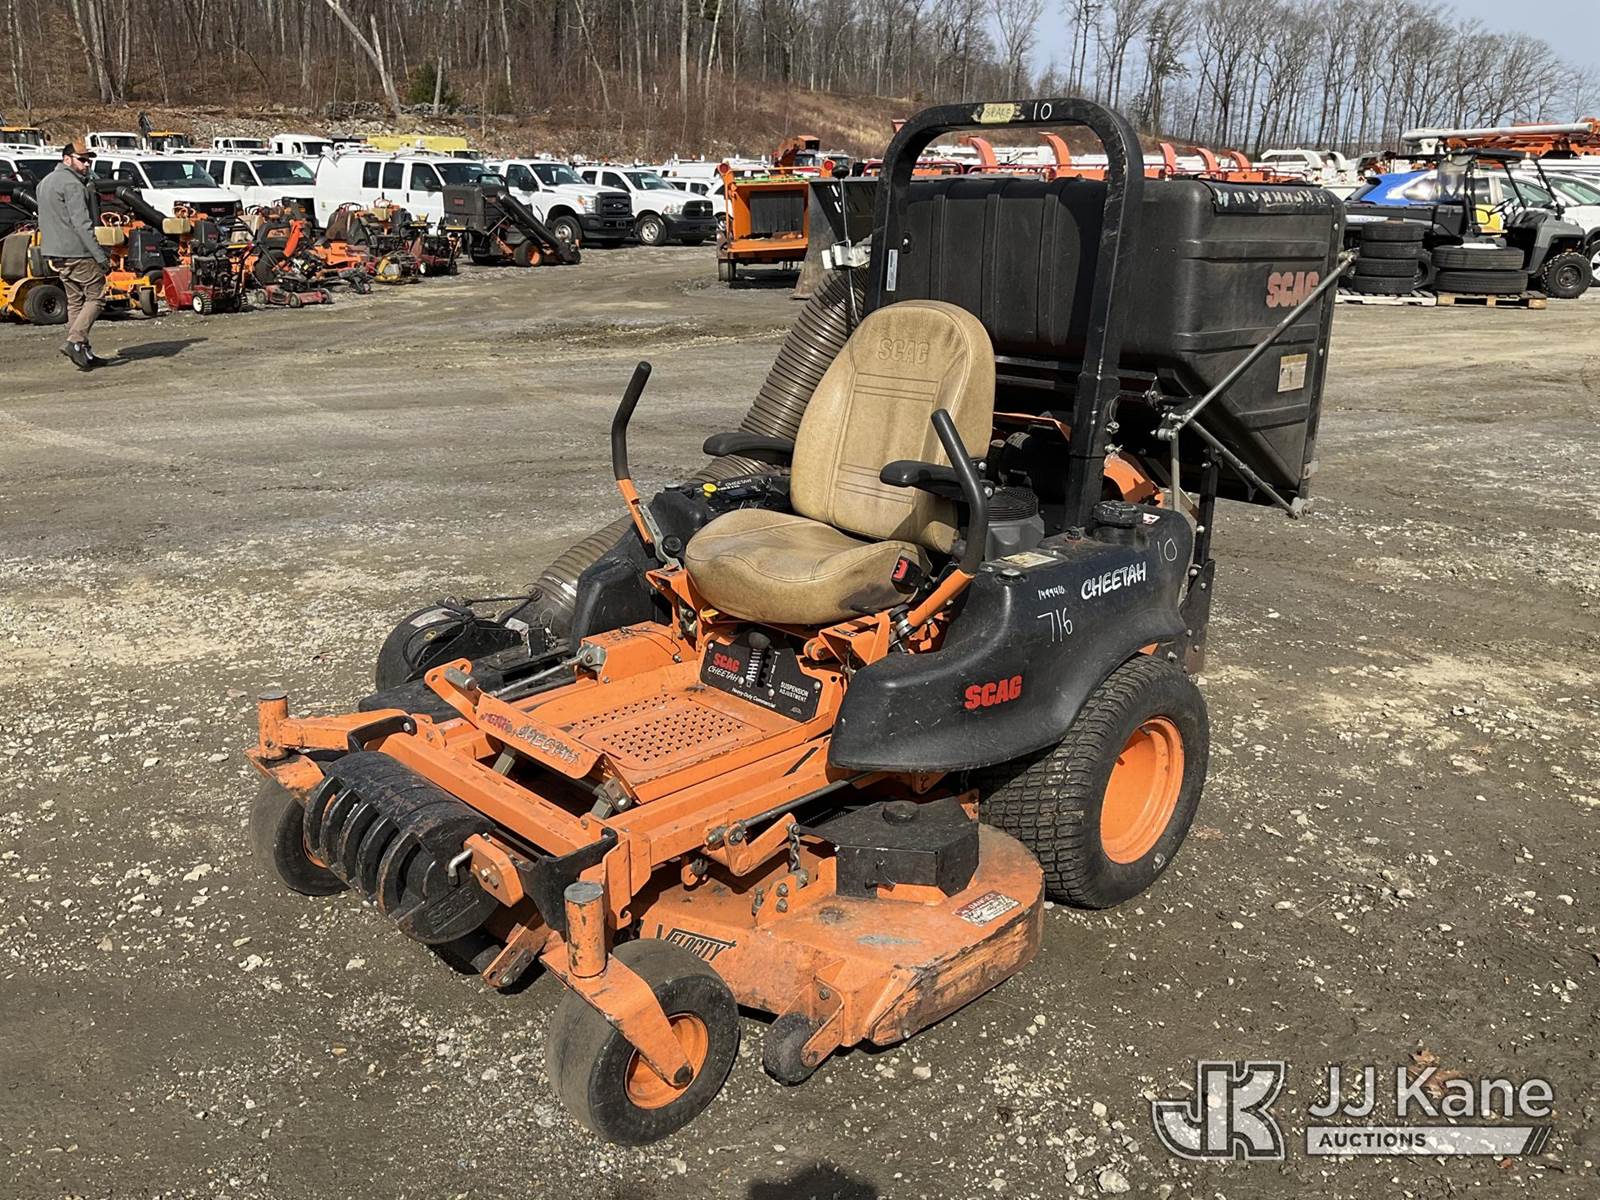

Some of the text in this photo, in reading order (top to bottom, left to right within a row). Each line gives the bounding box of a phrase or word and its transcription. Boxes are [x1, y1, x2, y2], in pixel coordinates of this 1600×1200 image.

[1033, 102, 1052, 120] 10
[1266, 271, 1320, 309] SCAG
[878, 338, 930, 365] SCAG
[1157, 538, 1178, 564] 10
[1081, 561, 1147, 600] CHEETAH
[1037, 608, 1073, 643] 716
[707, 665, 740, 682] CHEETAH
[713, 652, 741, 673] SCAG
[779, 688, 808, 703] ADJUSTMENT
[780, 681, 809, 698] SUSPENSION
[964, 674, 1023, 710] SCAG
